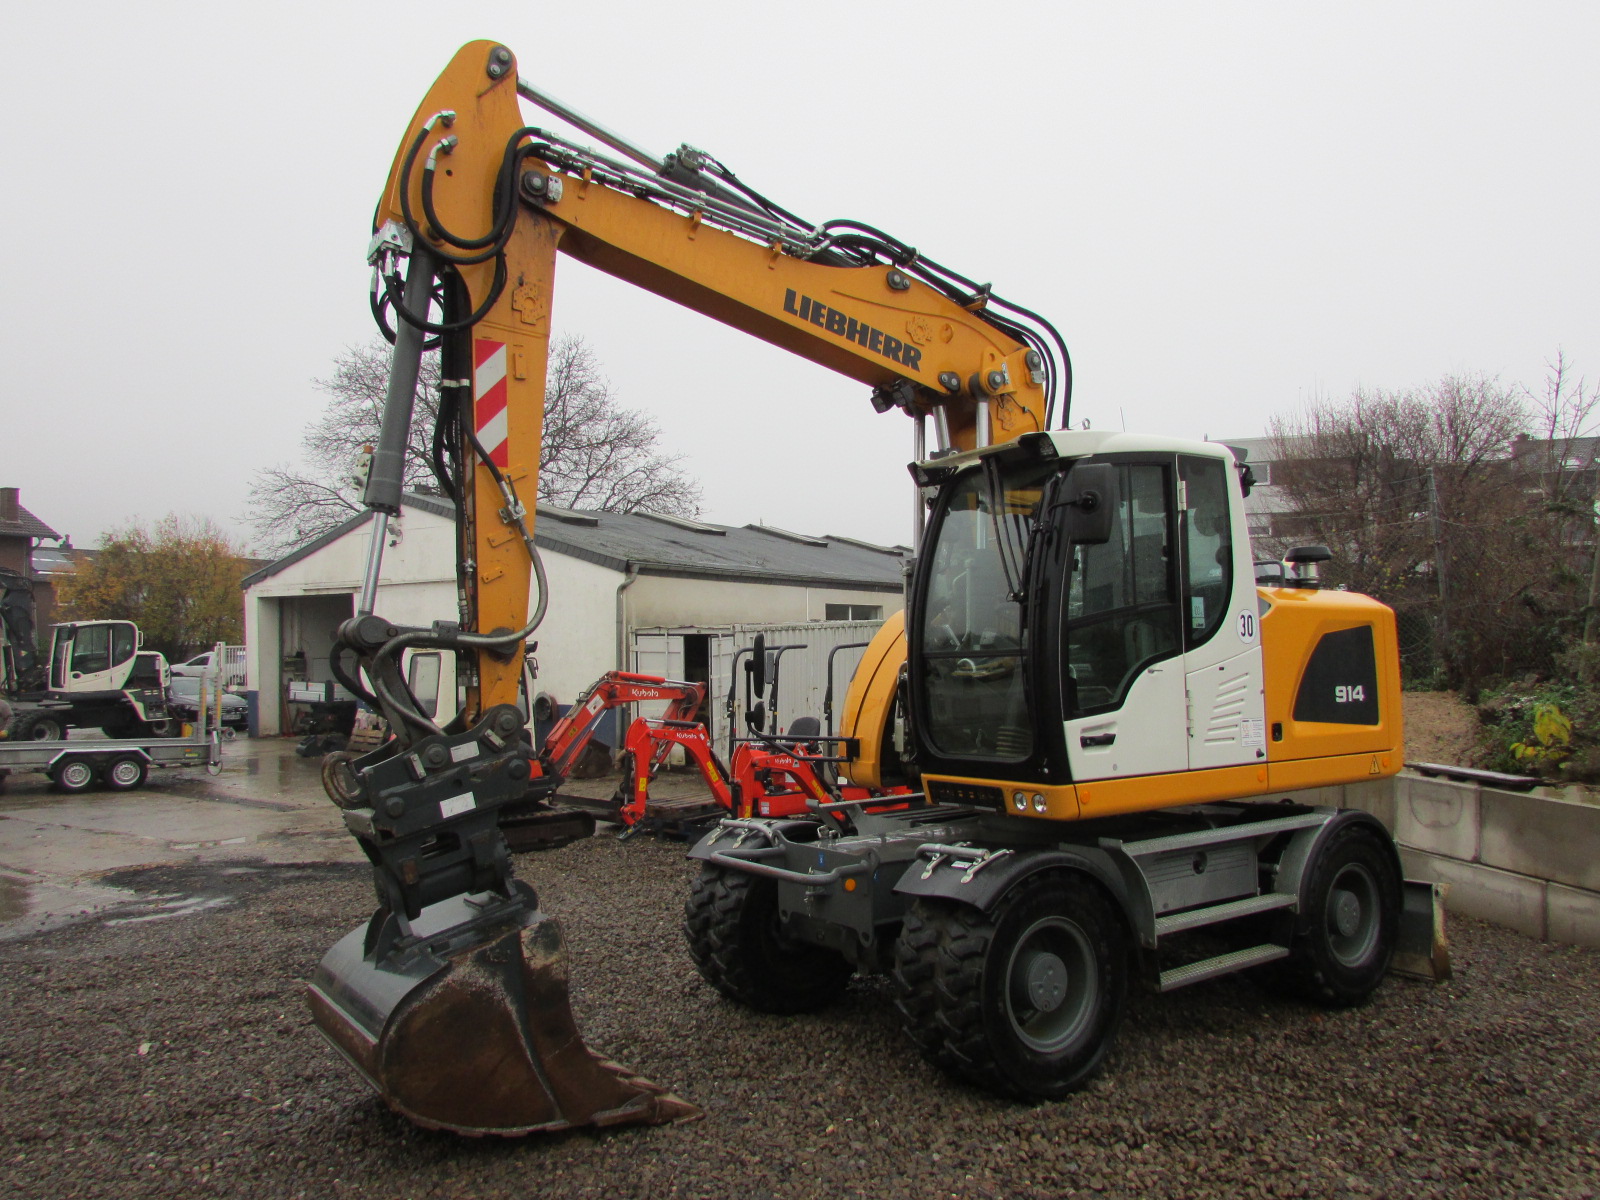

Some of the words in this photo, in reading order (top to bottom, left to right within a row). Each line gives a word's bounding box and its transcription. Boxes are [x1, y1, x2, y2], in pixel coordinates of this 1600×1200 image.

[783, 288, 923, 372] LIEBHERR
[1240, 615, 1254, 637] 30
[631, 688, 659, 697] Kubota
[1335, 685, 1365, 703] 914
